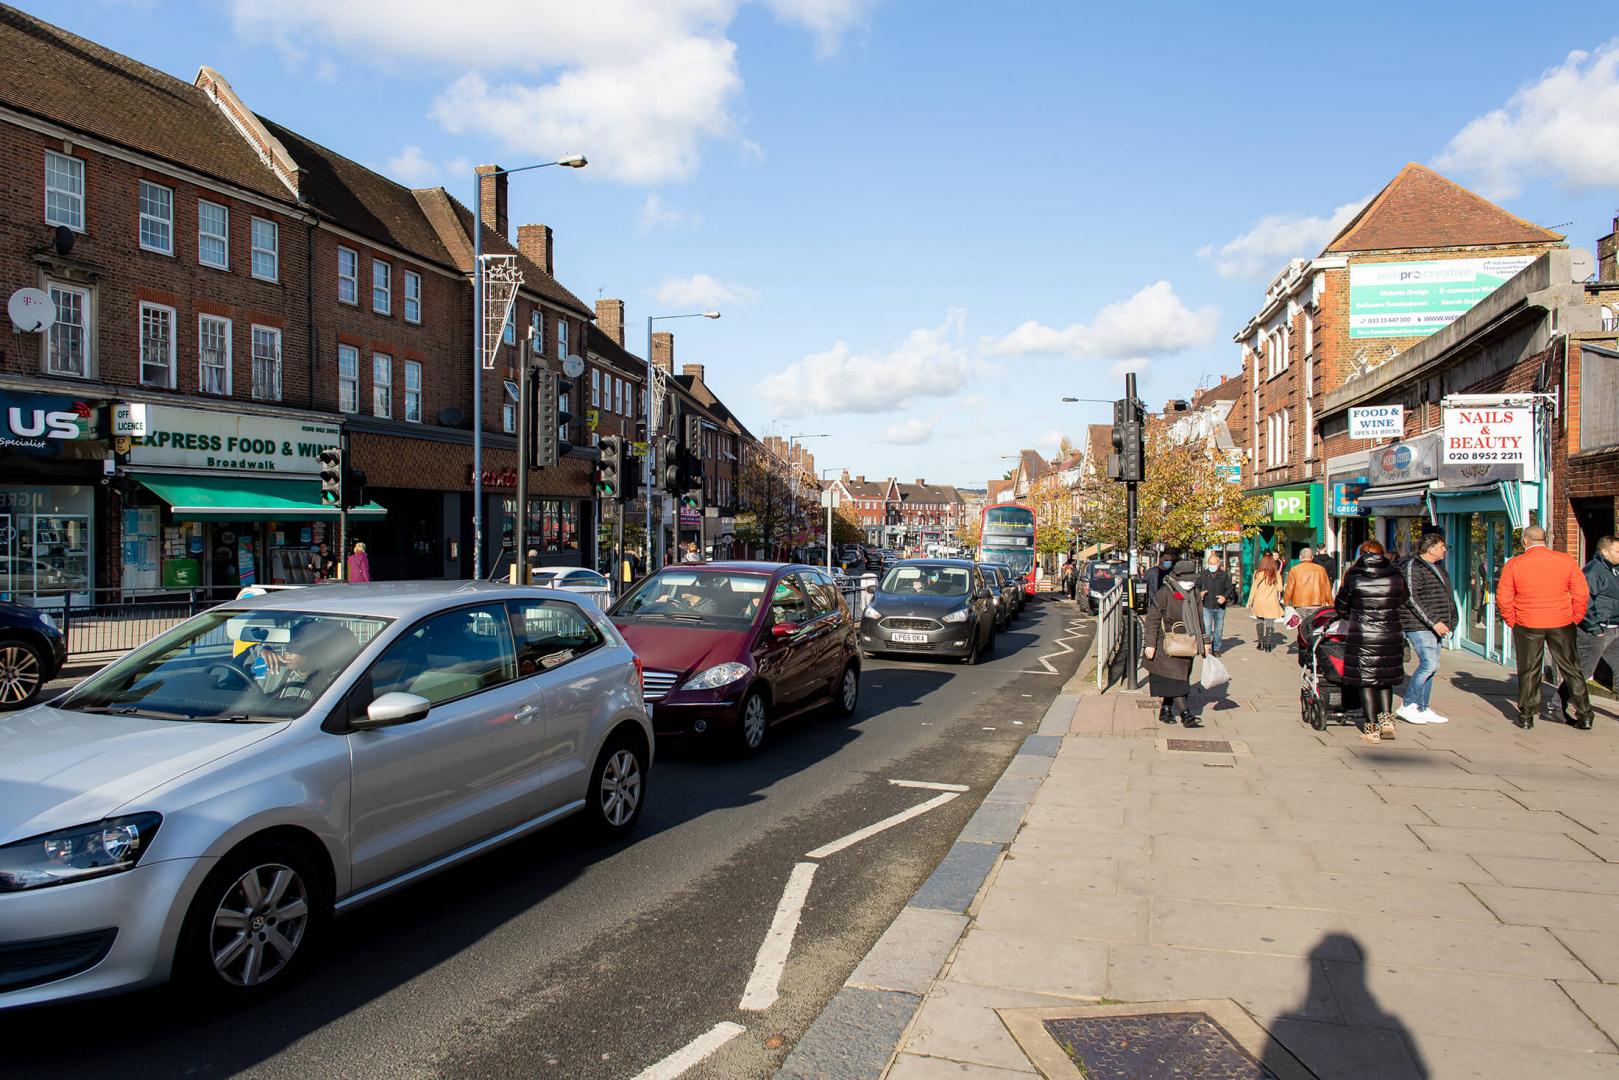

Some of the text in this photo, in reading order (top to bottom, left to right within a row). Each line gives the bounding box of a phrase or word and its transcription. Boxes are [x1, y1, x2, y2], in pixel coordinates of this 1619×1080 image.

[117, 410, 129, 419] OFF
[1353, 407, 1400, 418] FOOD &
[1459, 411, 1514, 424] NAILS
[117, 422, 143, 431] LICENCE
[1360, 419, 1395, 428] WINE
[1480, 425, 1491, 435] &
[0, 437, 48, 449] Specialist
[131, 431, 338, 458] EXPRESS FOOD & WIN
[1449, 436, 1522, 449] BEAUTY
[1449, 452, 1523, 460] 020 8952 2211
[207, 457, 276, 471] Broadwalk
[1336, 505, 1365, 513] GREGGS
[894, 633, 925, 642] LP65 OKA
